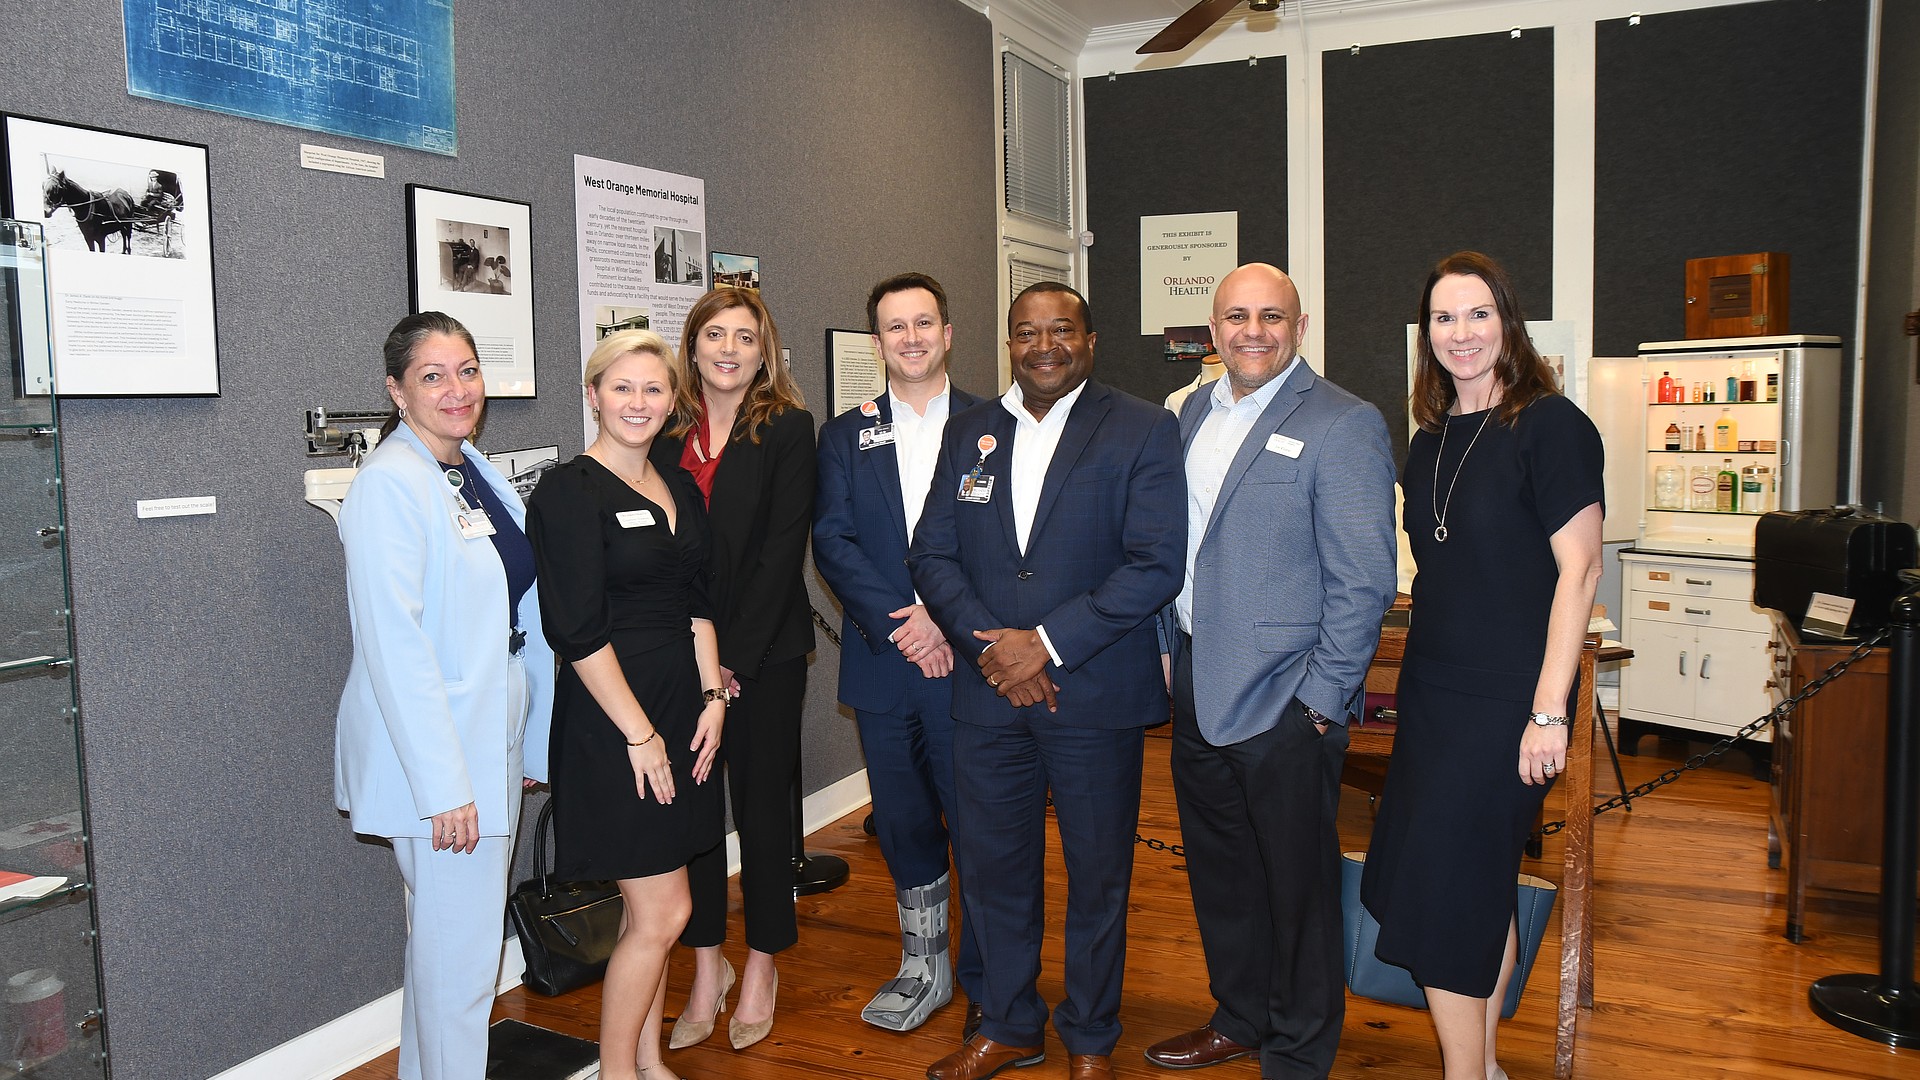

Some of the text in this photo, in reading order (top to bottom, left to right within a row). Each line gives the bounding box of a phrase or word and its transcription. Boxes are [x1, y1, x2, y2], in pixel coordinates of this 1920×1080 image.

[584, 175, 699, 205] West Orange Memorial Hospital
[616, 208, 636, 216] population
[1164, 276, 1214, 286] ORLANDO
